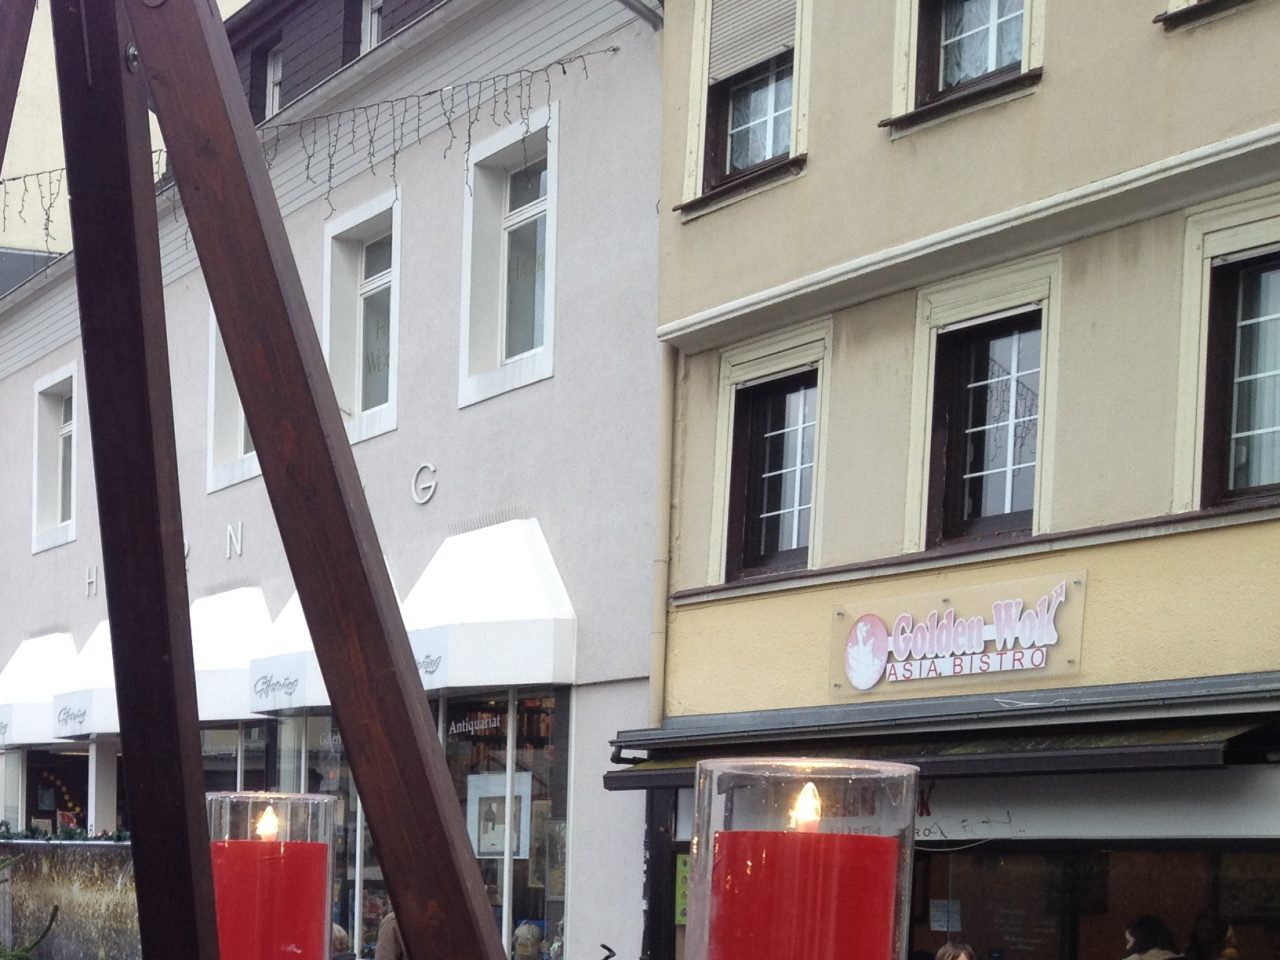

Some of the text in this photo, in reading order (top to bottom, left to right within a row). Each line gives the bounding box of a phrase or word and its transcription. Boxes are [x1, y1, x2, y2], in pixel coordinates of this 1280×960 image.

[893, 581, 1065, 661] Golden Wok
[887, 649, 1046, 681] ASIA BISTRO
[449, 714, 501, 736] Antiquariat
